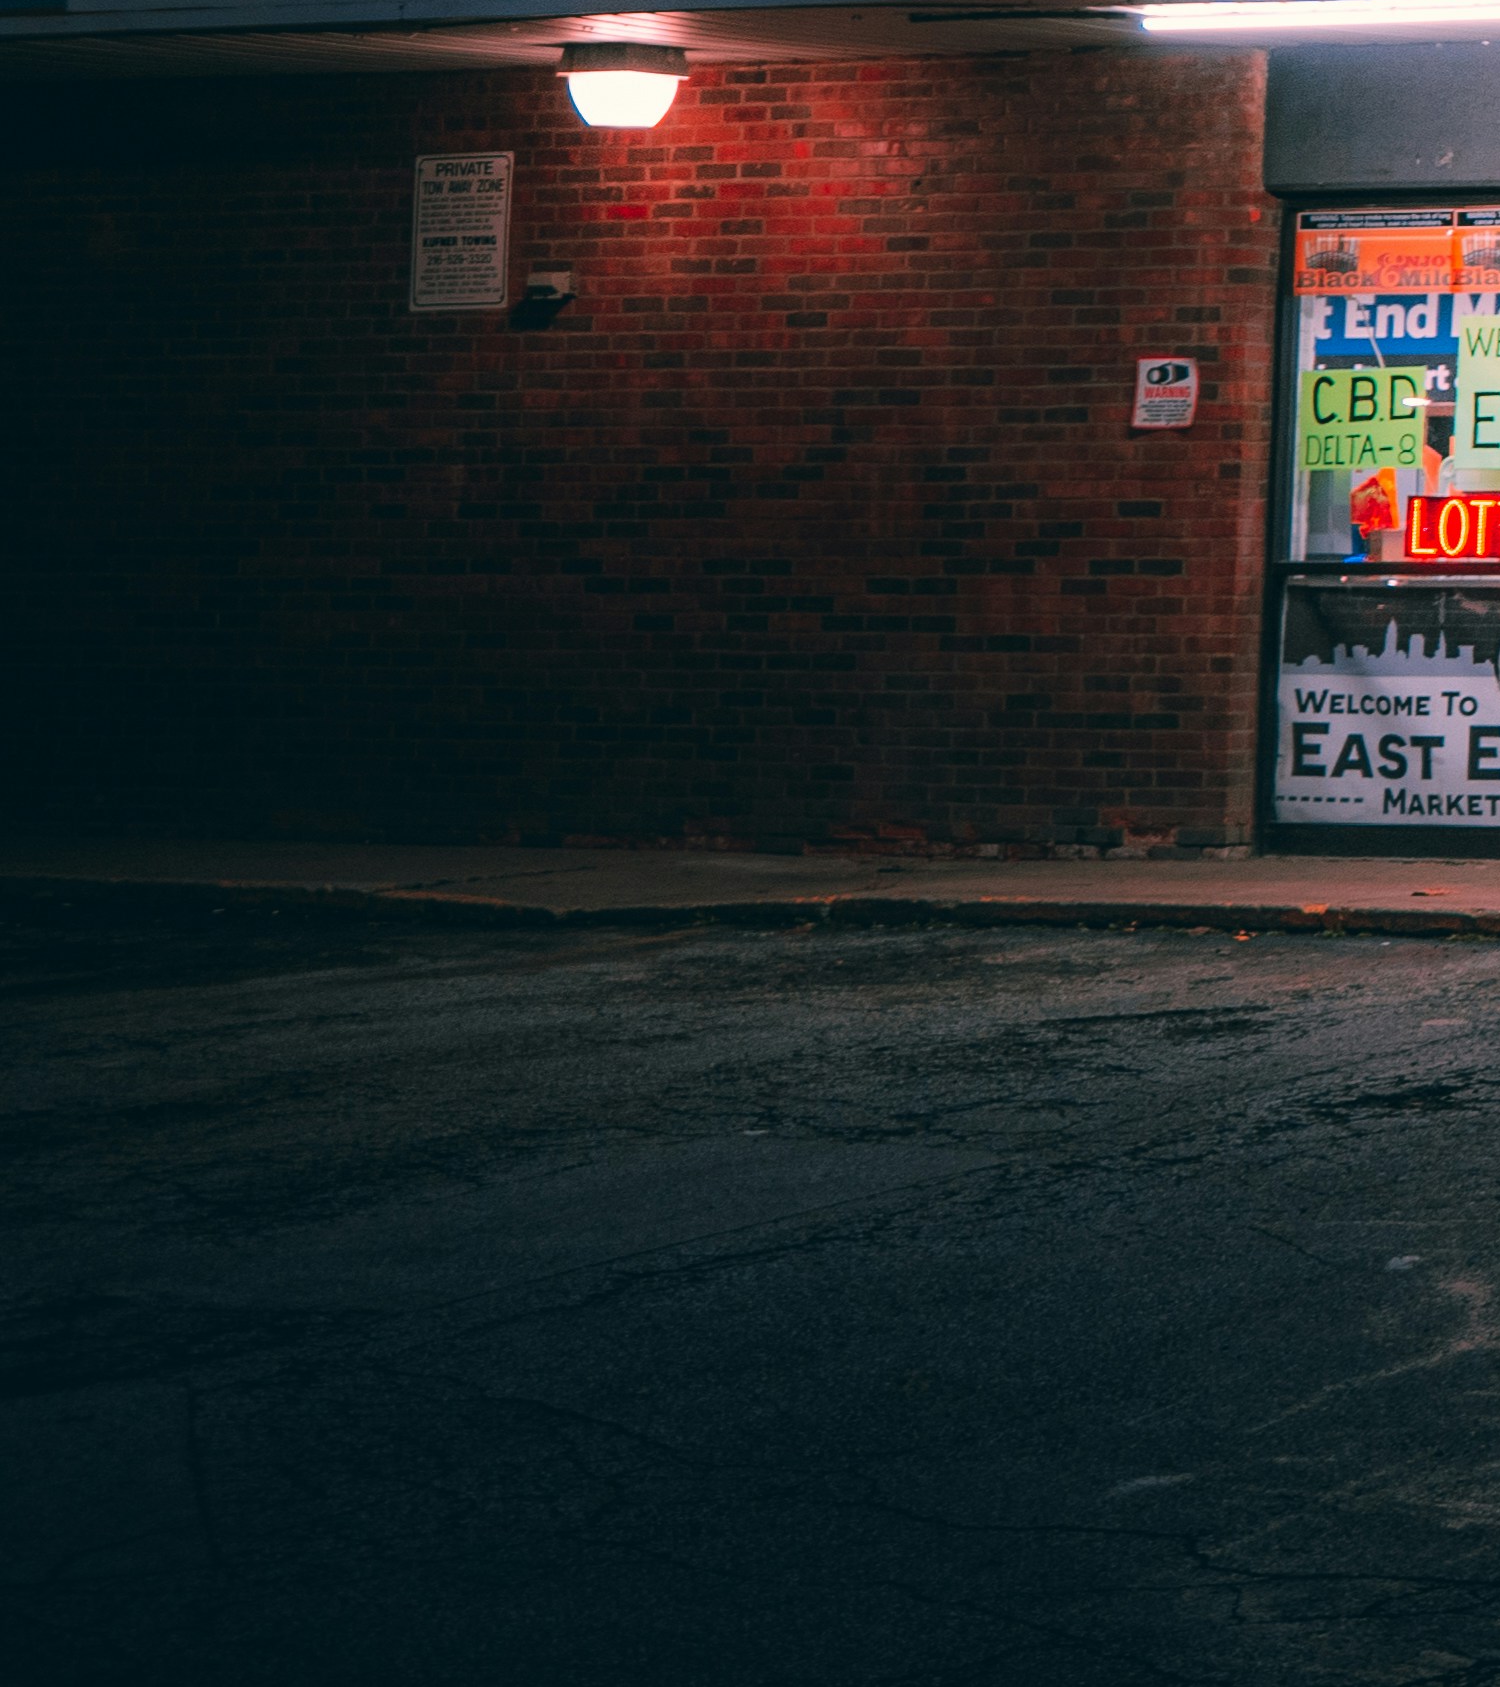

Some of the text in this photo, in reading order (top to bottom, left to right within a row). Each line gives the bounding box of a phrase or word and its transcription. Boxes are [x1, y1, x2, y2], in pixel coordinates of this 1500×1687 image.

[435, 161, 494, 177] PRIVATE
[423, 180, 444, 195] TOW
[477, 178, 505, 193] ZONE
[1344, 293, 1440, 340] End
[1305, 432, 1417, 466] DELTA-8
[1294, 688, 1430, 716] WELCOME
[1291, 721, 1445, 780] EAST
